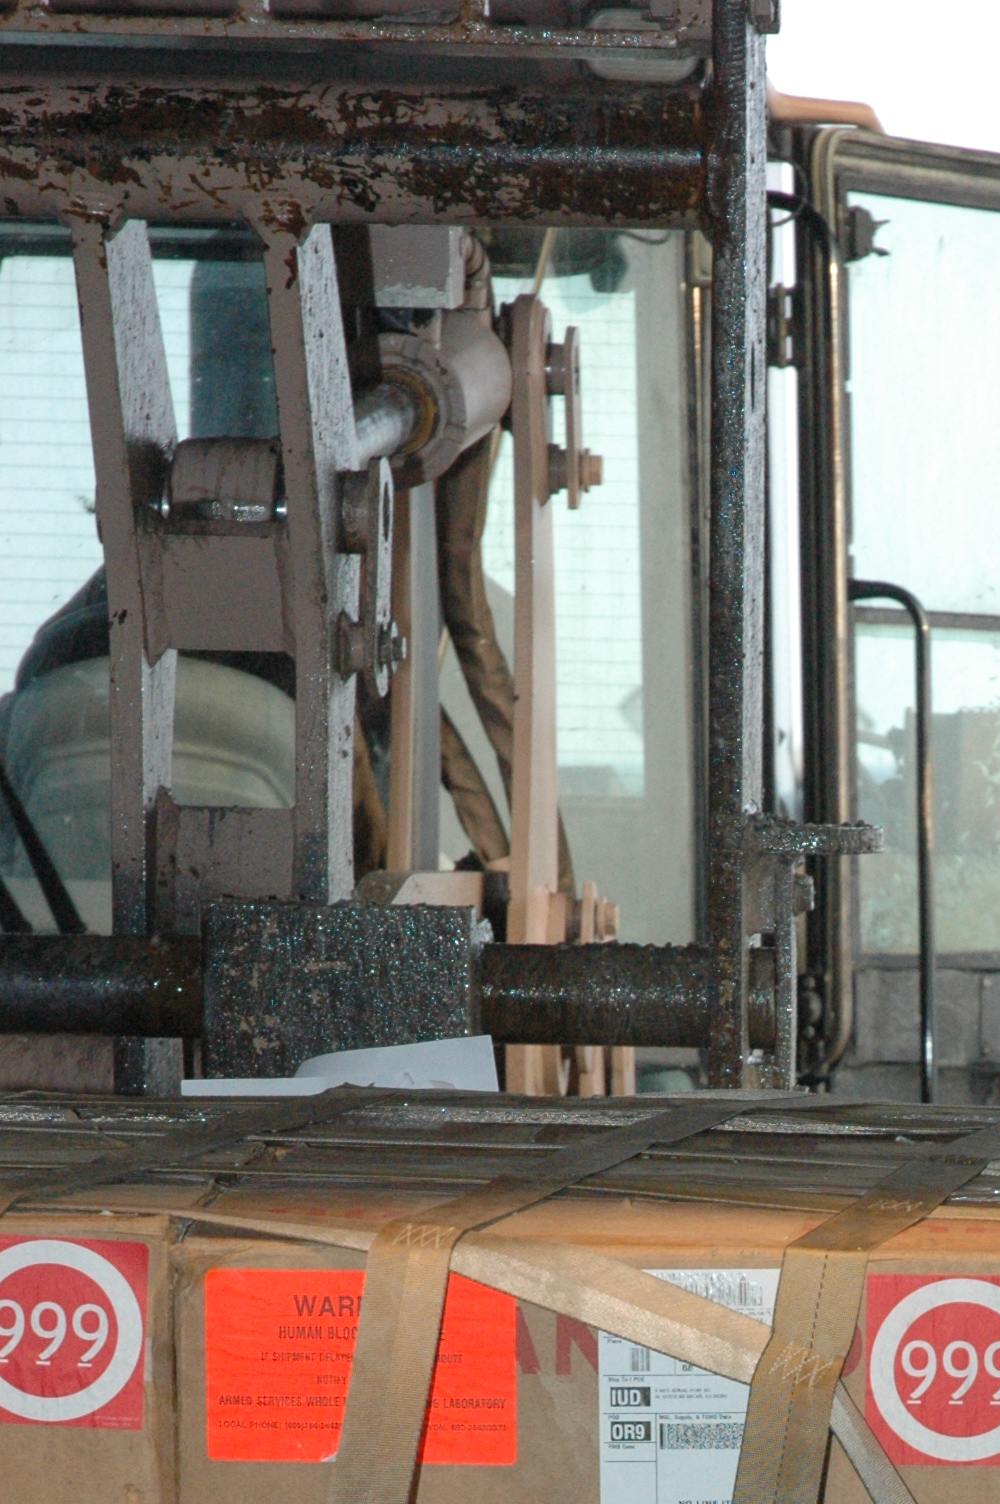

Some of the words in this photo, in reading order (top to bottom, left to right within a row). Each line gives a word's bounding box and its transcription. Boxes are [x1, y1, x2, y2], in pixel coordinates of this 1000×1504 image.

[294, 1294, 362, 1317] WAR
[0, 1299, 109, 1362] 999
[279, 1326, 322, 1339] HUMAN
[328, 1326, 358, 1340] BLOO
[219, 1395, 253, 1406] ARMED
[256, 1396, 302, 1407] SERVICES
[307, 1397, 340, 1407] WHOLE
[443, 1398, 507, 1410] LABORATORY
[611, 1389, 642, 1406] IUD
[612, 1423, 646, 1440] OR9
